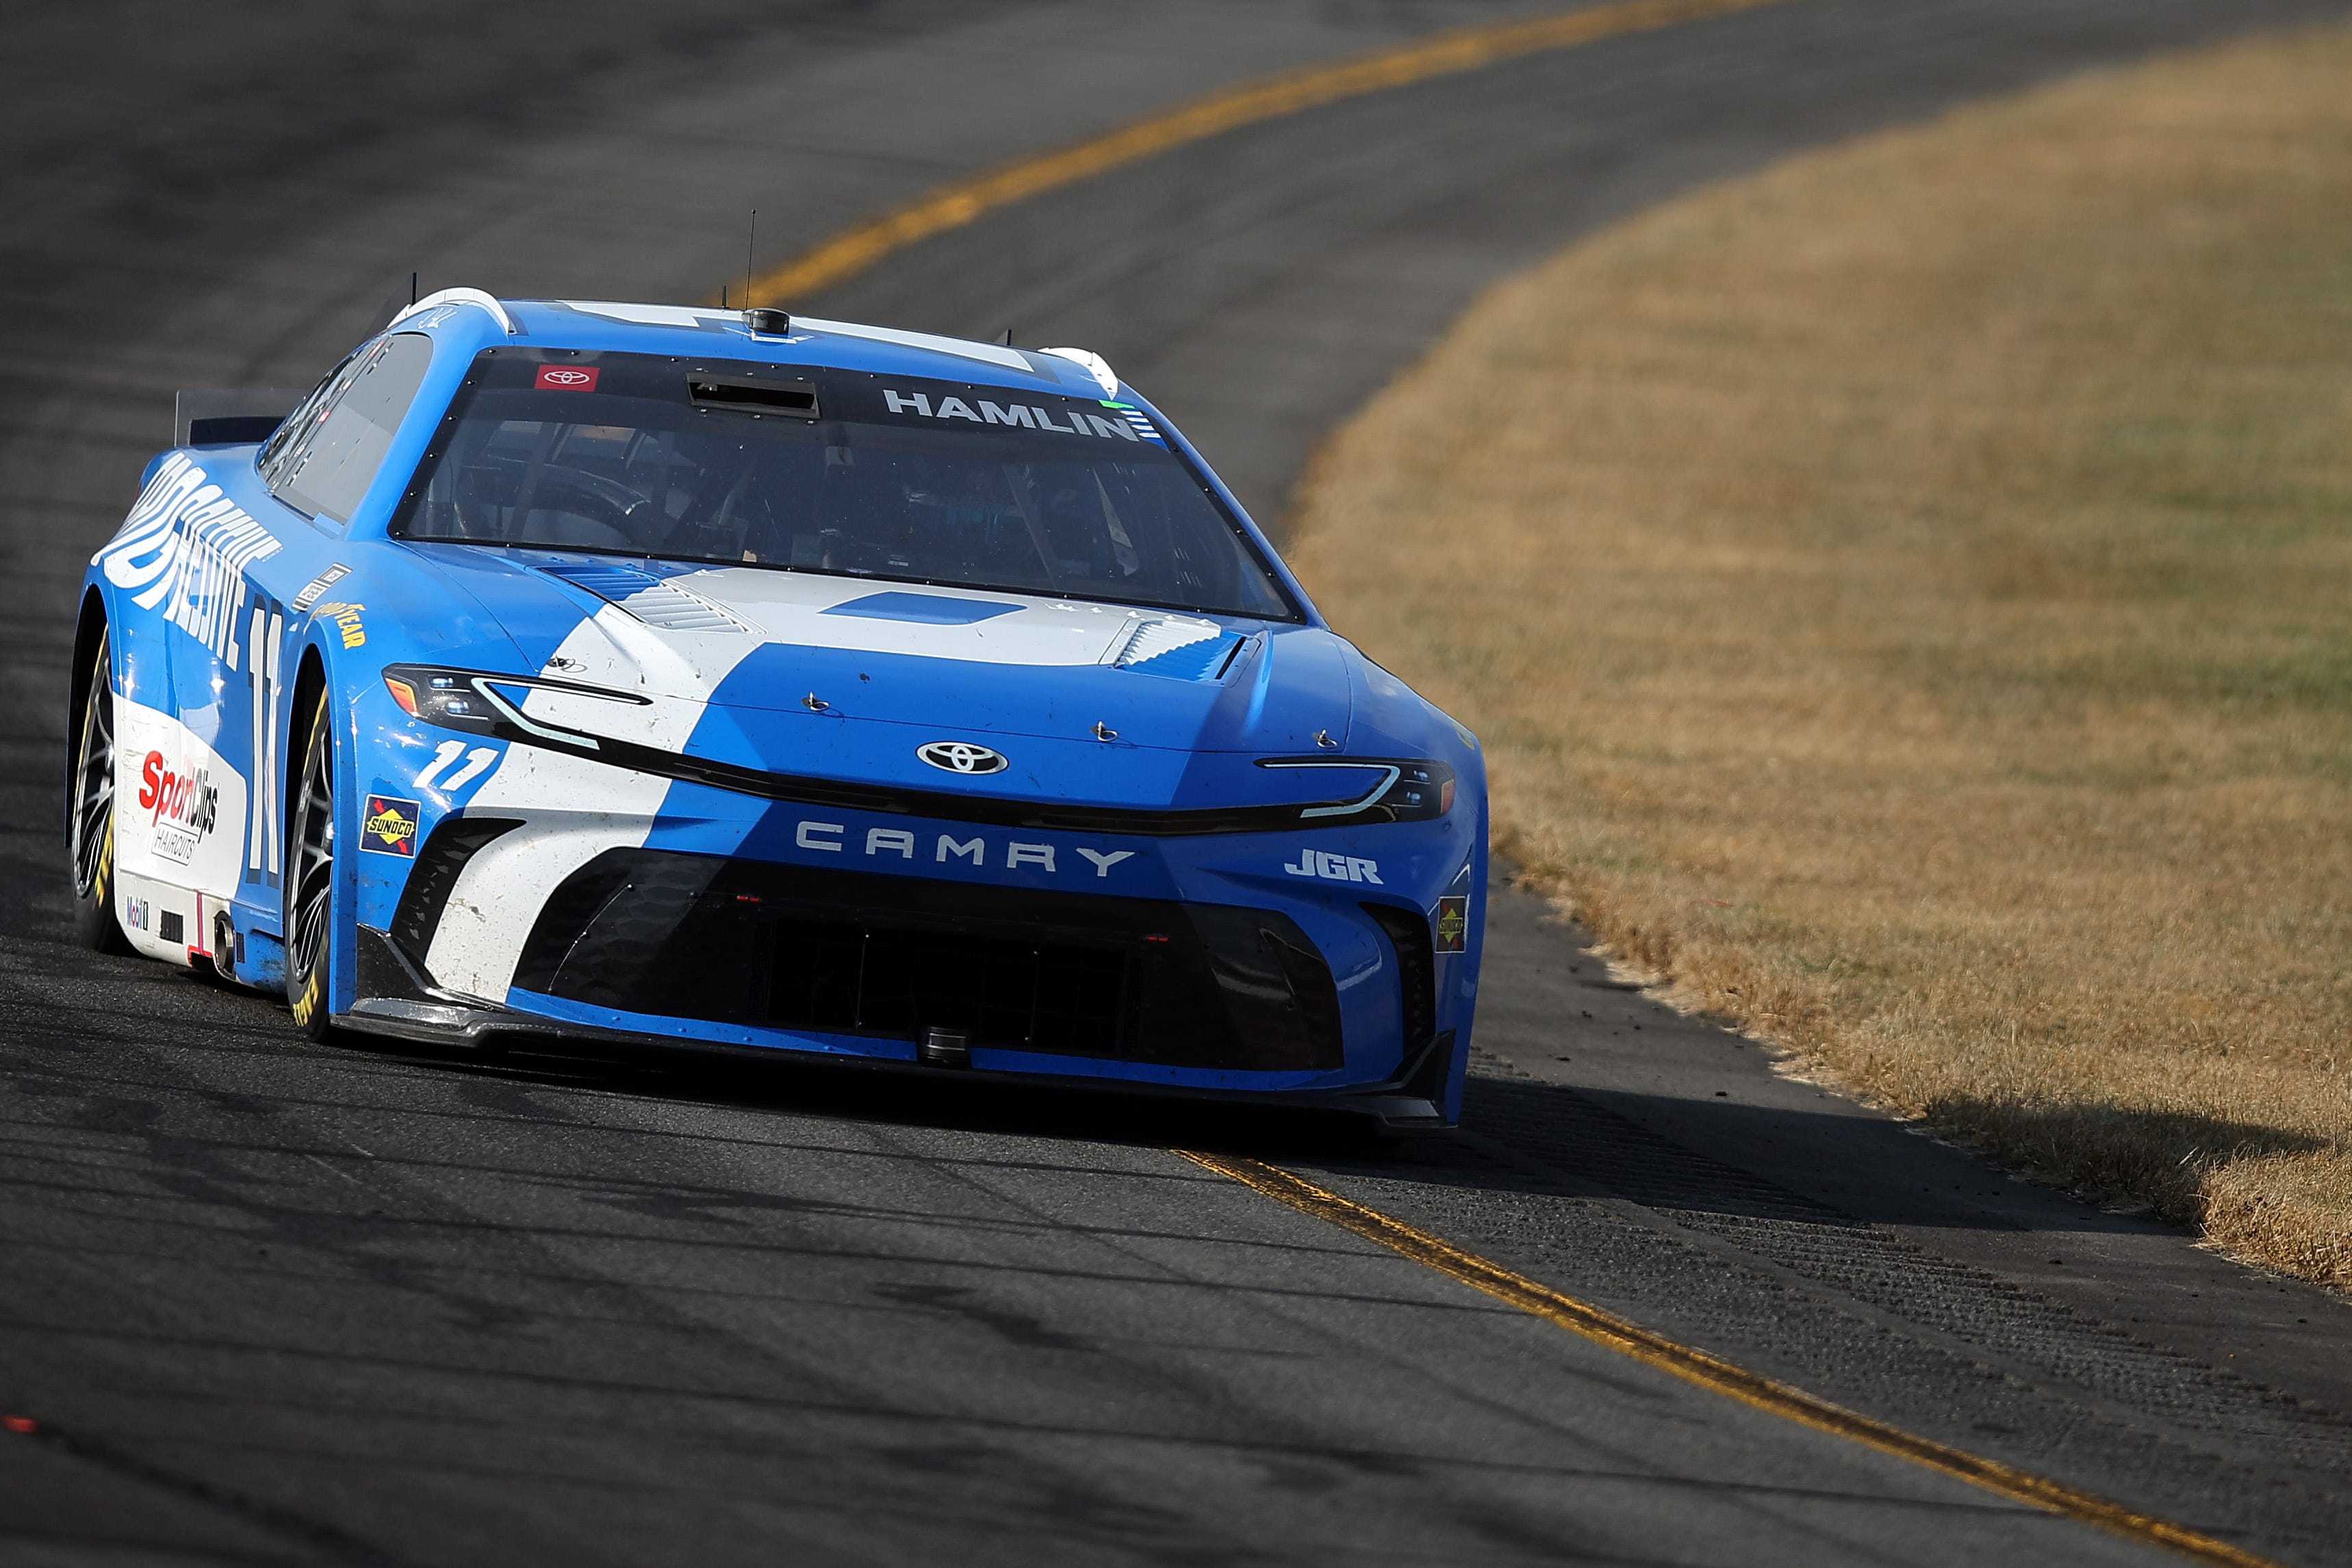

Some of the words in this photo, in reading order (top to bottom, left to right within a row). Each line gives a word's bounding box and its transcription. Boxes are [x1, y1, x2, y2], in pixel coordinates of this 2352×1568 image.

[883, 389, 1139, 442] HAMLIN
[249, 606, 283, 875] 11
[412, 740, 499, 791] 11
[154, 827, 196, 860] HAIRCUTS
[369, 818, 412, 836] SUNOCO
[796, 821, 1136, 877] CAMRY
[1284, 849, 1383, 884] JGR
